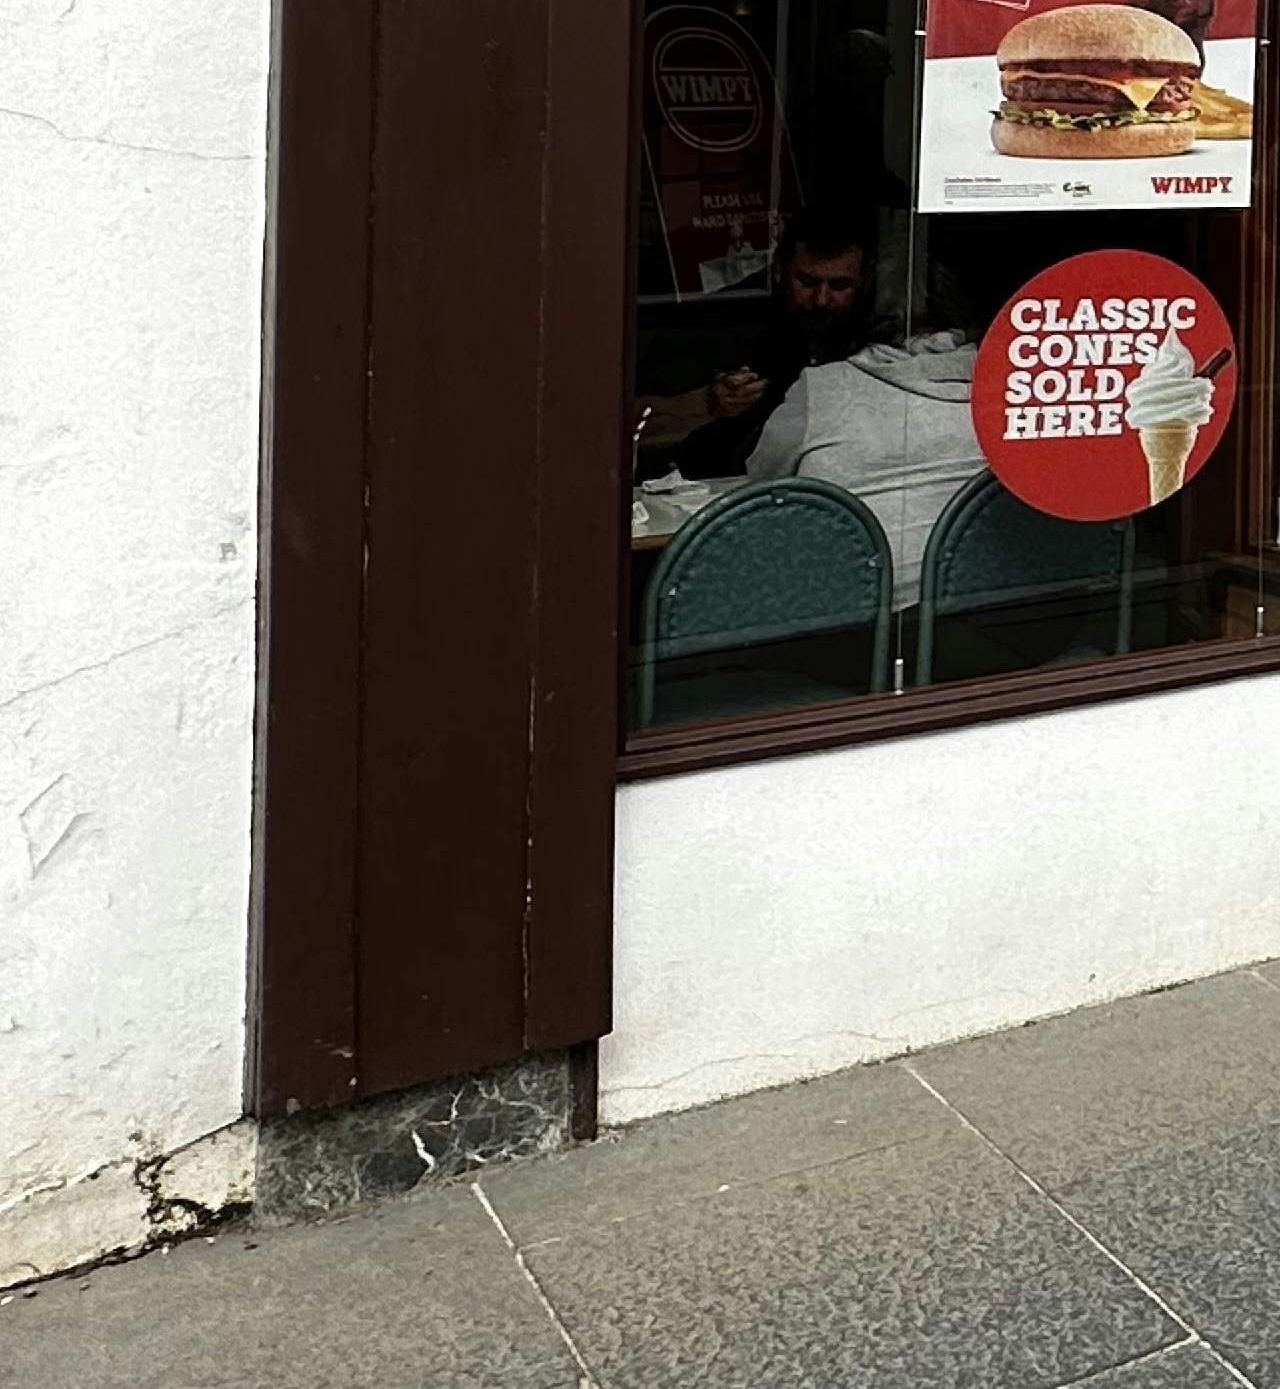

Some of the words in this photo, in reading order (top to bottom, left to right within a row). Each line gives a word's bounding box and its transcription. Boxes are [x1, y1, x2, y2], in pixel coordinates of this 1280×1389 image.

[660, 75, 752, 102] WIMPY
[1150, 176, 1234, 195] WIMPY
[1010, 297, 1197, 332] CLASSIC
[1008, 333, 1159, 368] CONES
[1004, 368, 1125, 404] SOLD
[1003, 403, 1124, 440] HERE
